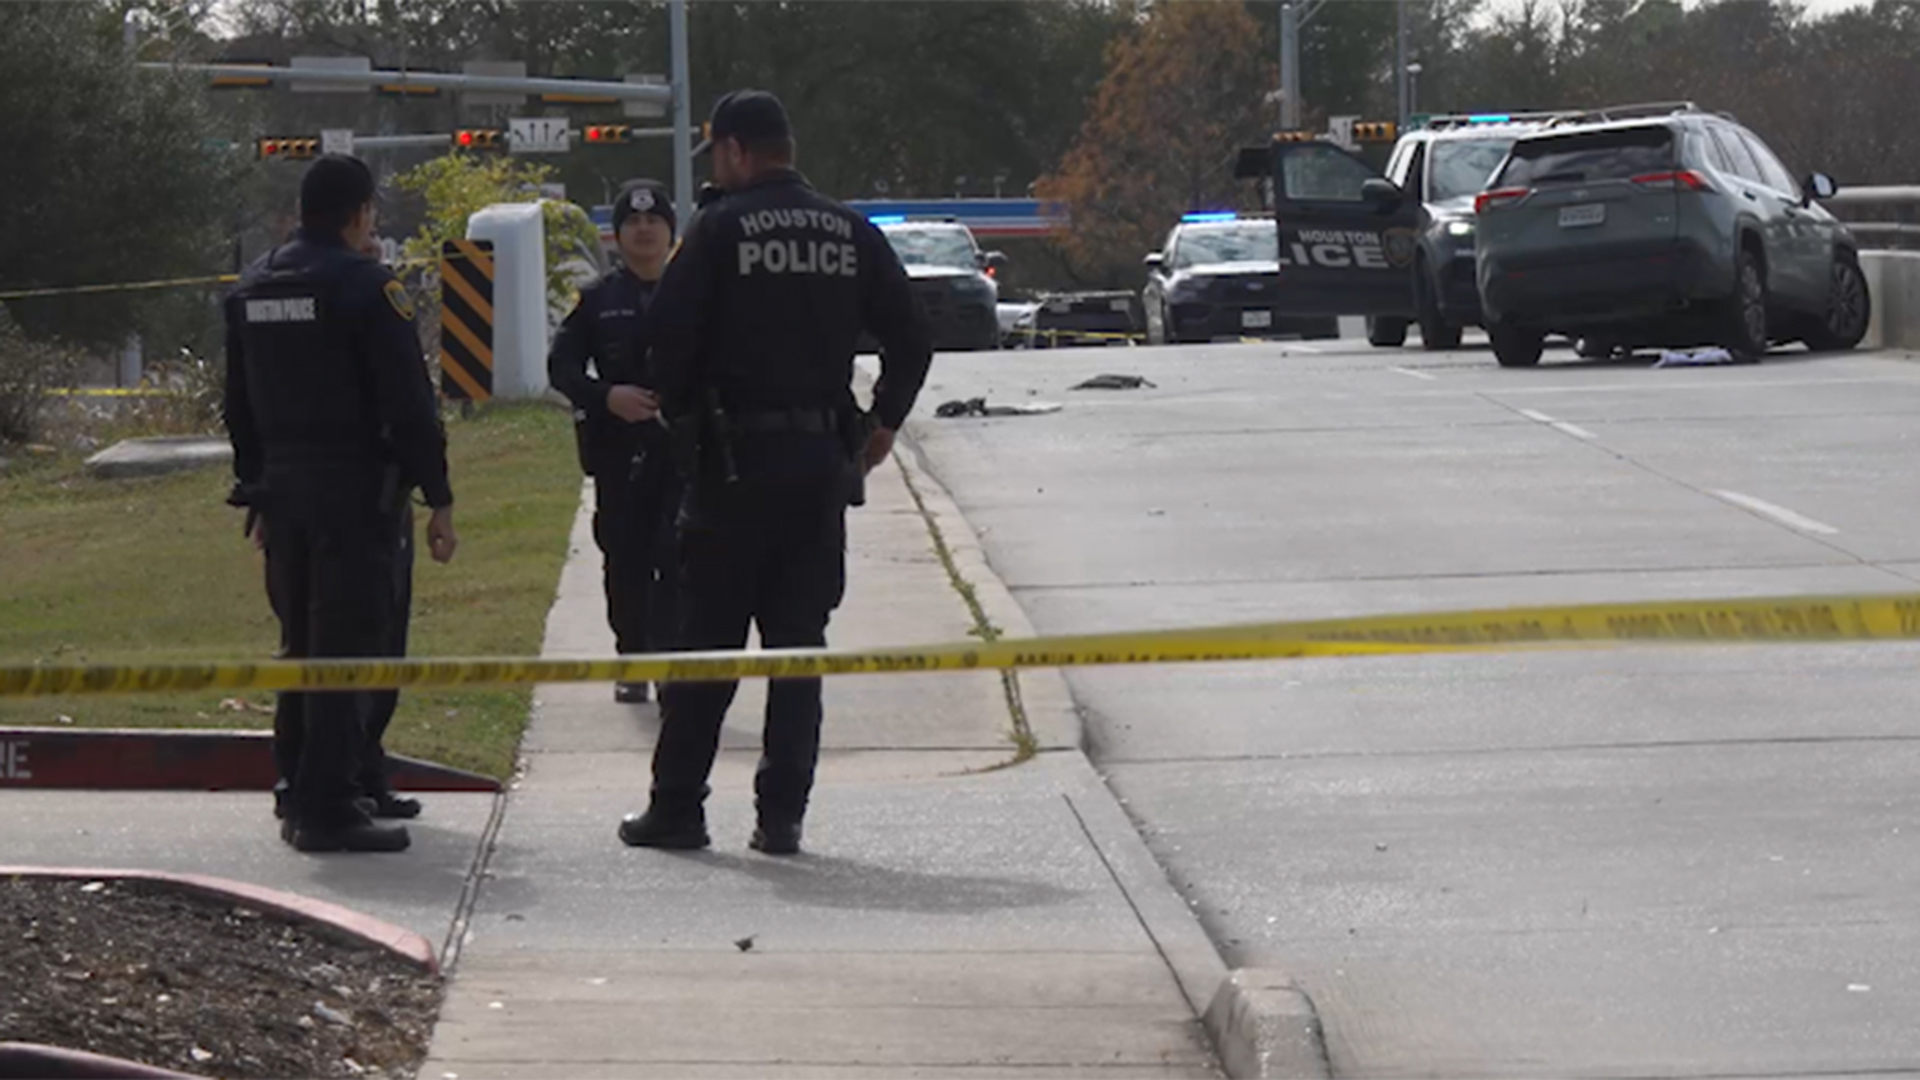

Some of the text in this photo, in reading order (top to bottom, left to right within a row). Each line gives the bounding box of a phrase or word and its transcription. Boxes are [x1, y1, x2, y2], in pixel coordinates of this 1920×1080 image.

[739, 208, 853, 240] HOUSTON
[1297, 229, 1380, 246] HOUSTON
[738, 239, 858, 277] POLICE
[0, 740, 32, 779] E
